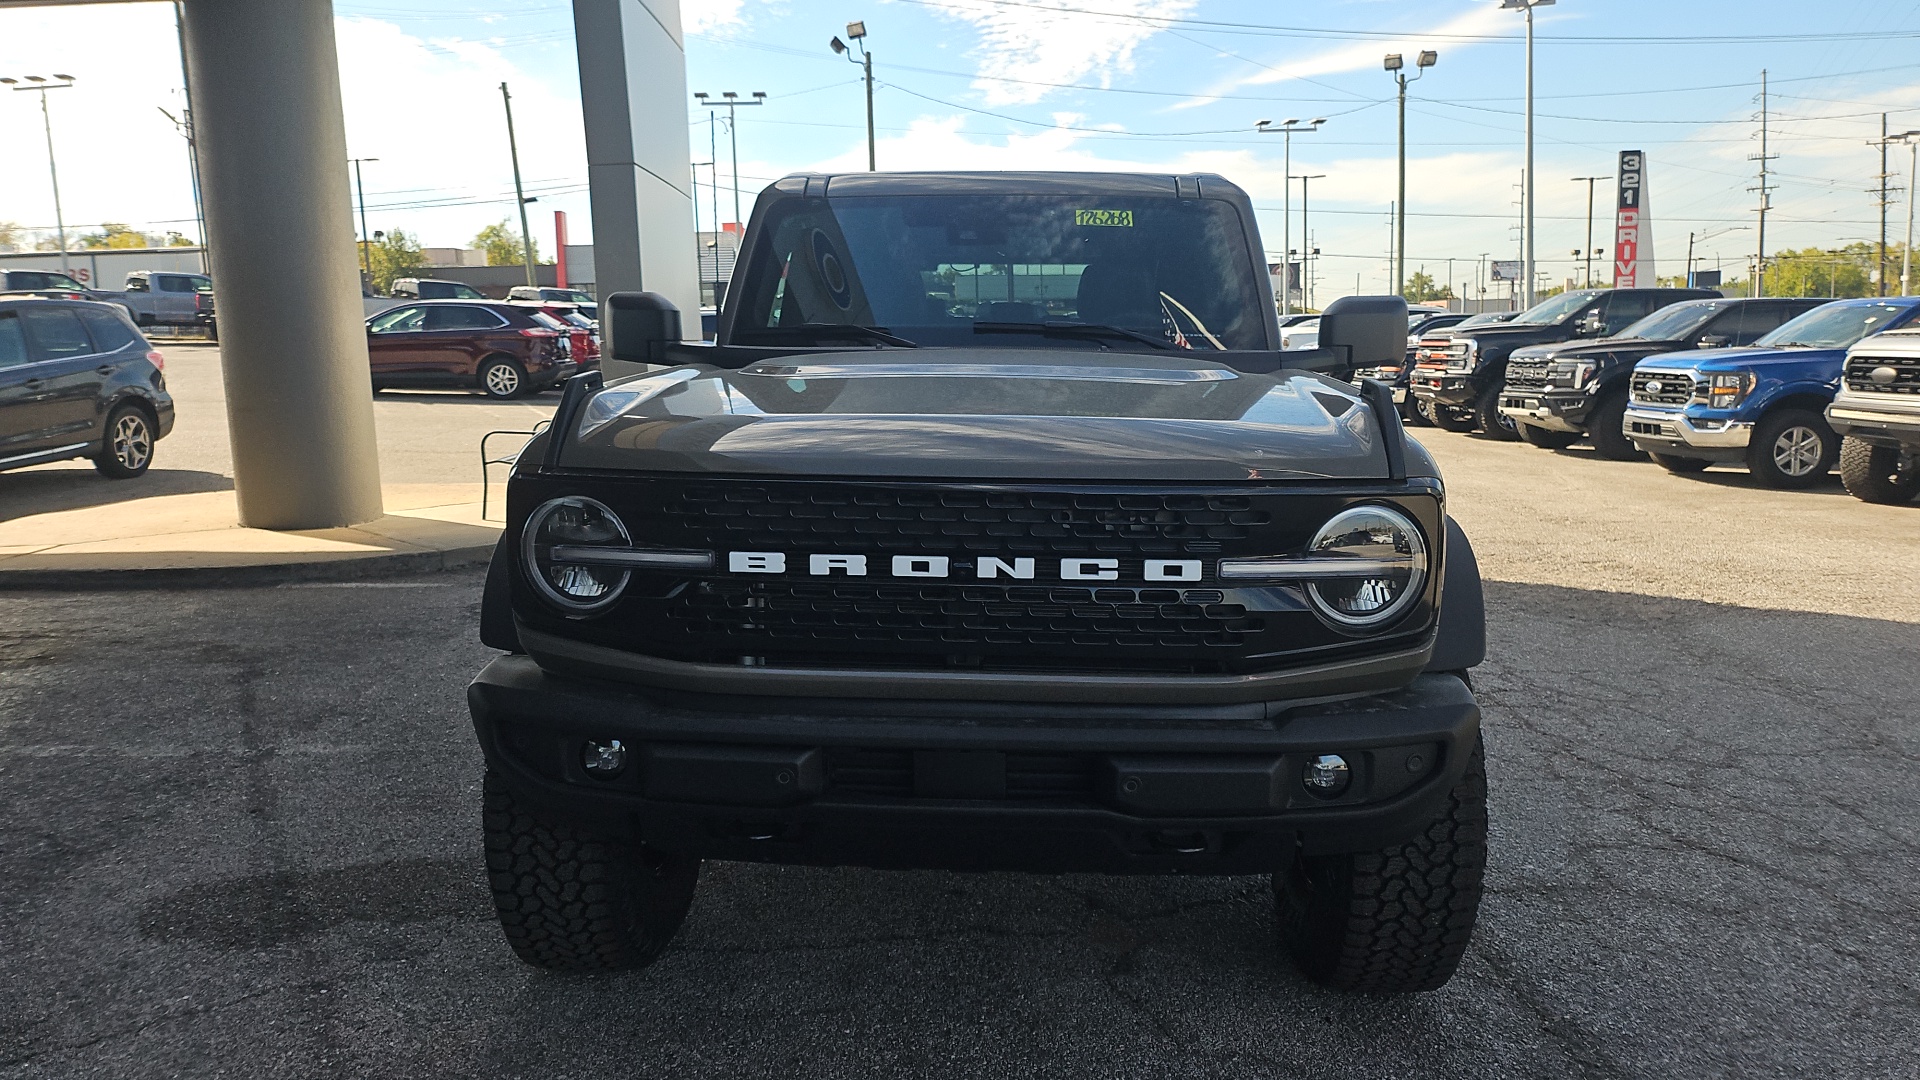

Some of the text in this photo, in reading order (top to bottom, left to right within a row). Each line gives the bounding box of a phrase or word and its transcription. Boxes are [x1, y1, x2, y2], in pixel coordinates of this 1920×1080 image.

[1617, 155, 1640, 289] 321 DRIVE
[728, 551, 1203, 582] BRONCO
